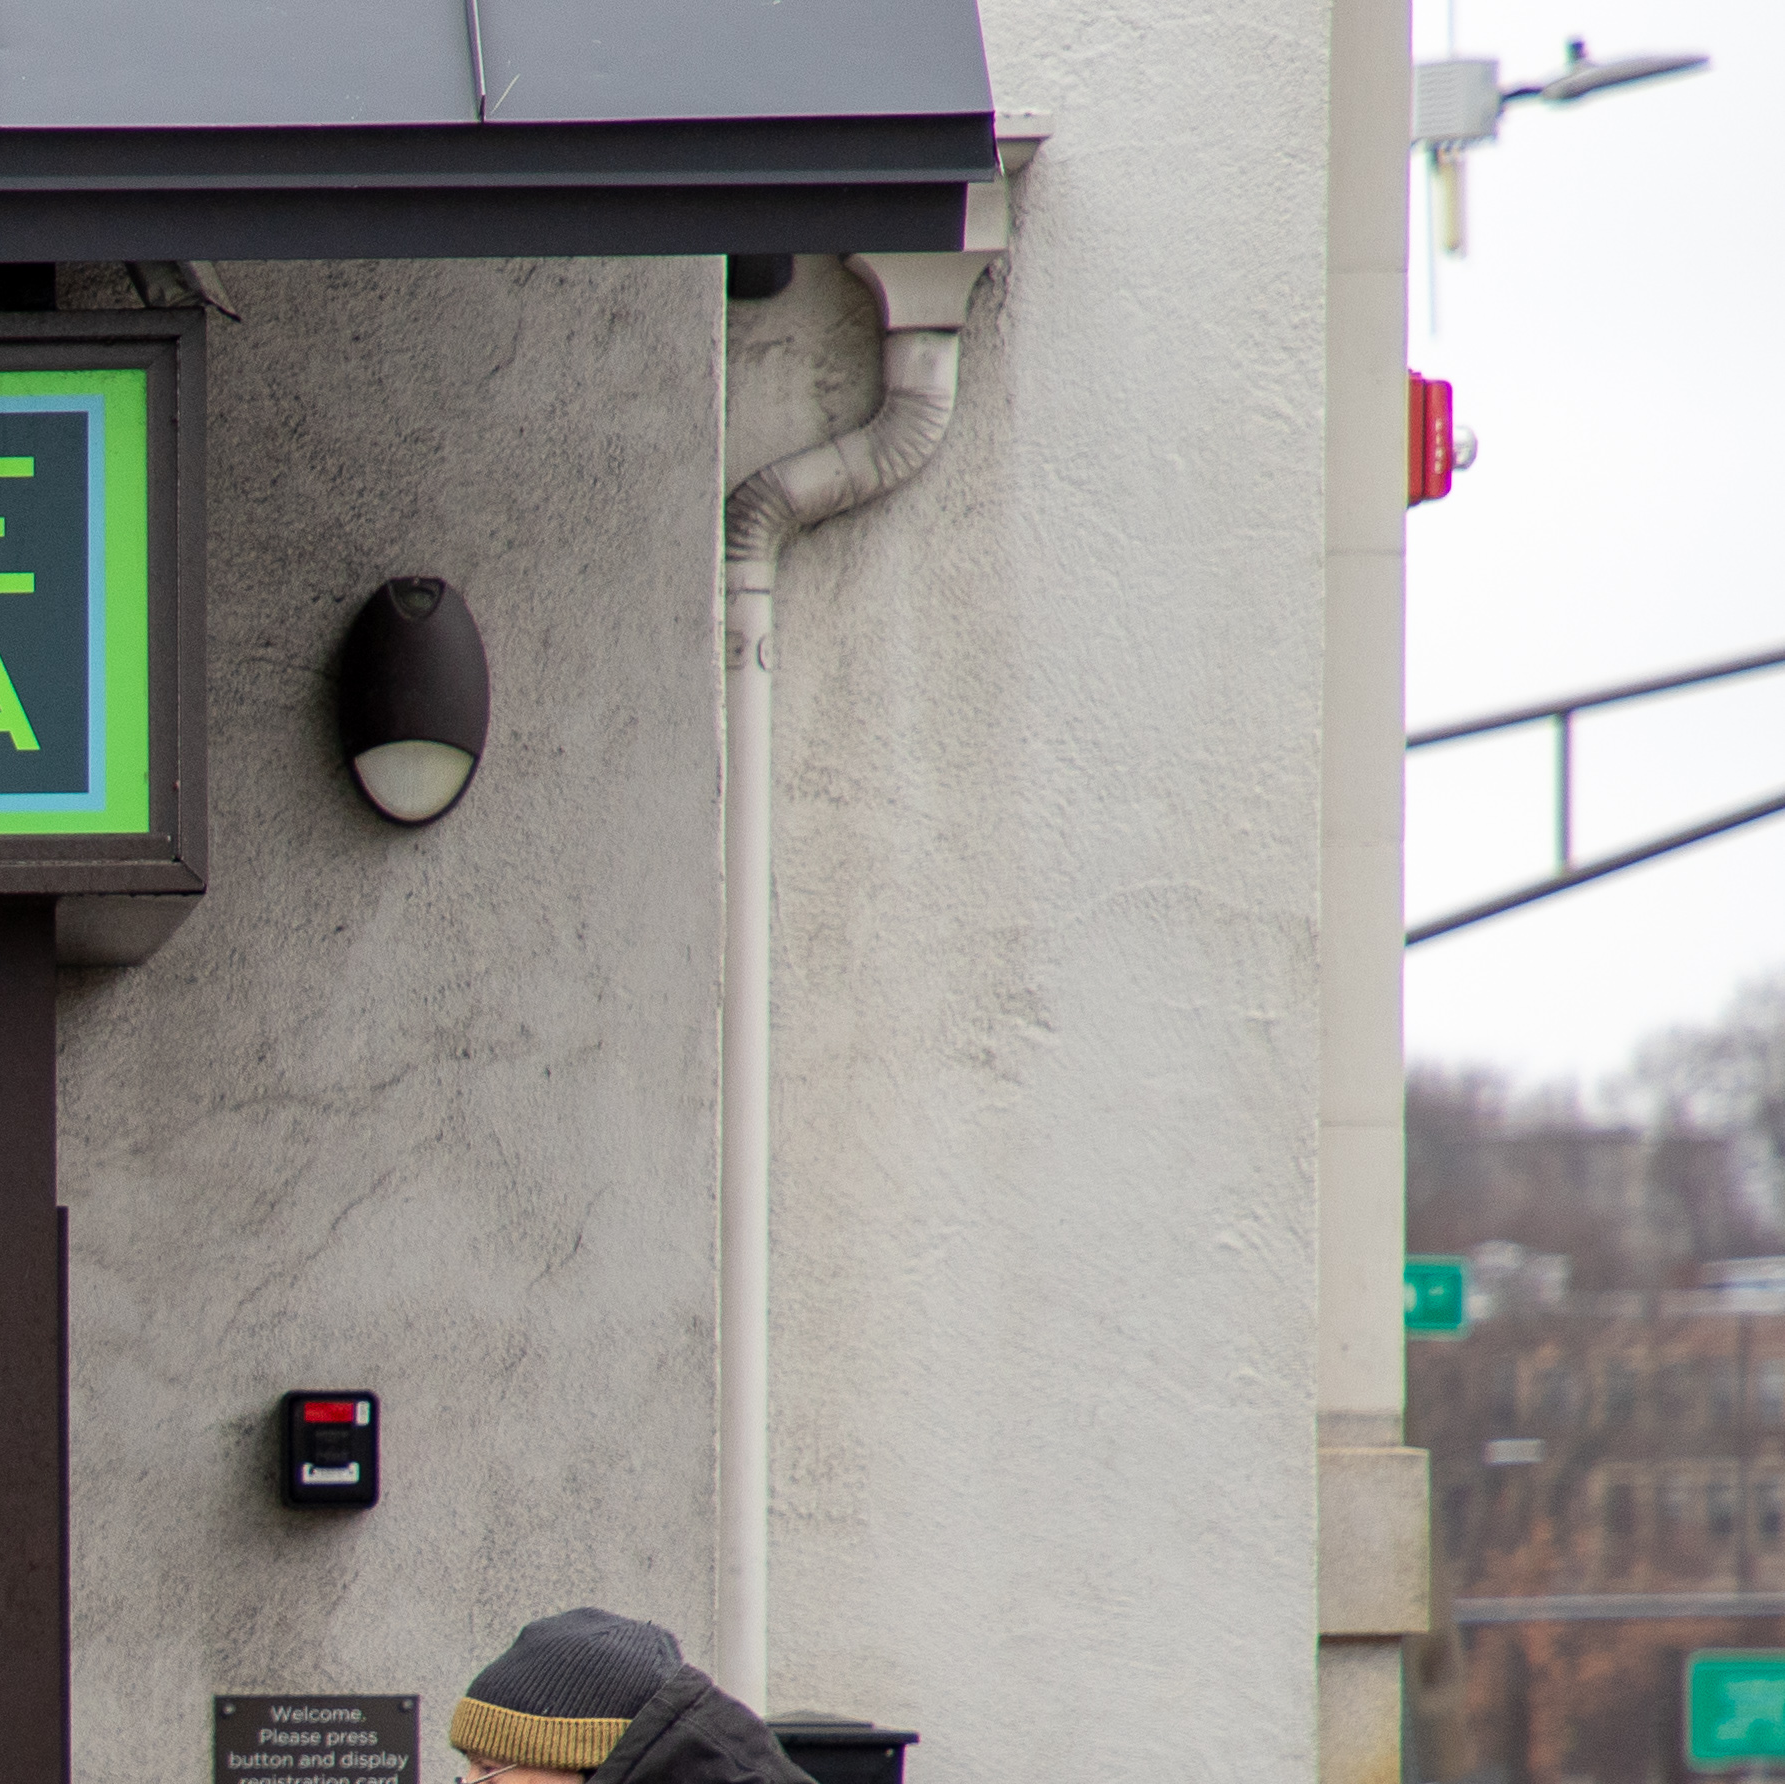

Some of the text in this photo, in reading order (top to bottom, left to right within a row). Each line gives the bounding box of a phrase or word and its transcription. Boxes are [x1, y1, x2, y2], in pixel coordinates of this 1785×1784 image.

[270, 1706, 367, 1723] Welcome.
[259, 1728, 378, 1747] Please press
[228, 1751, 409, 1771] button and display
